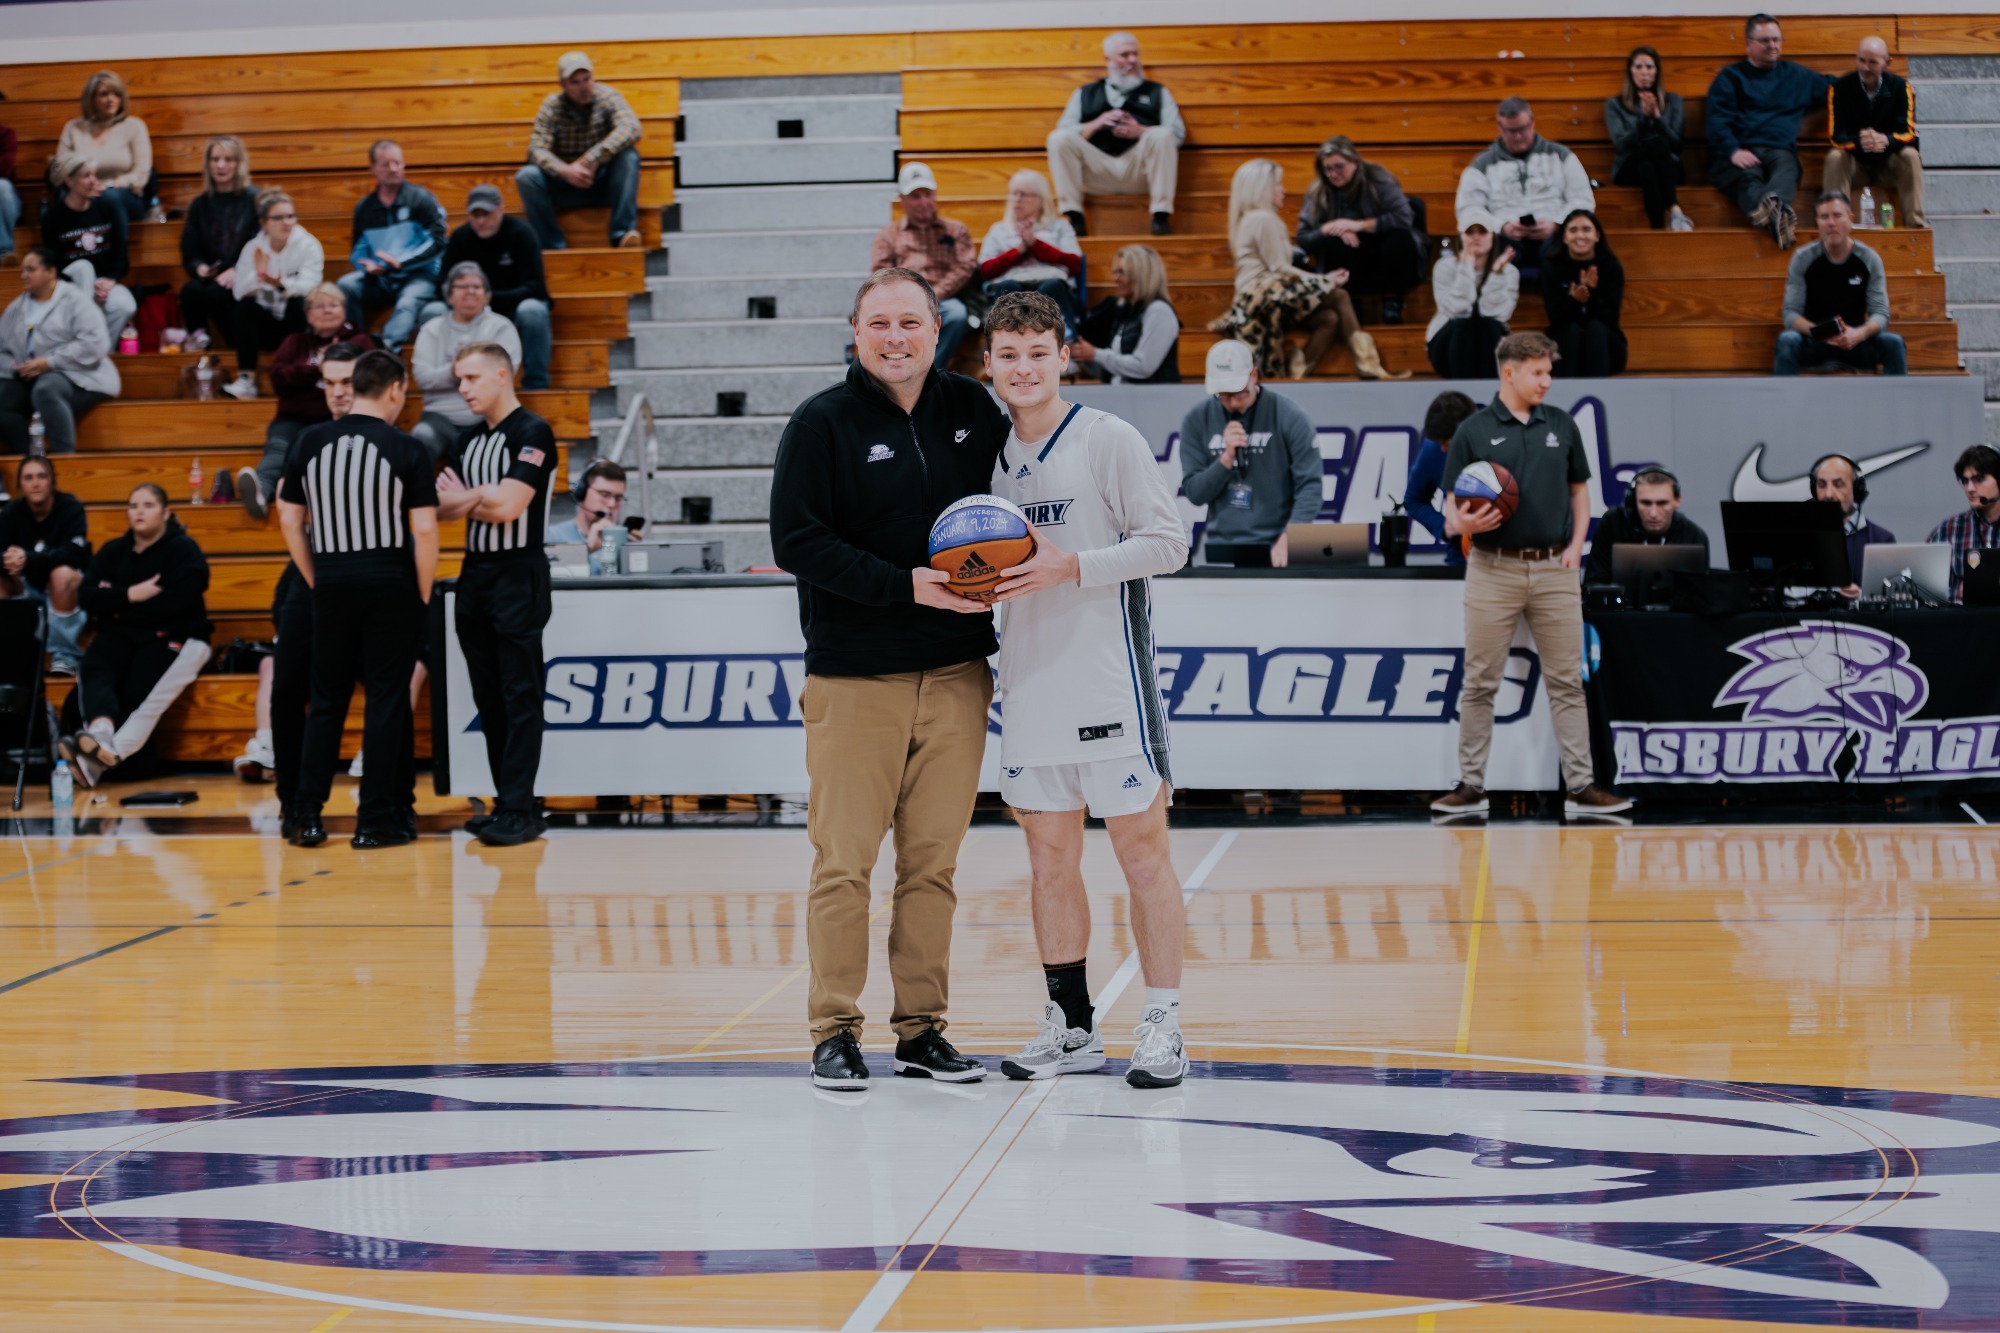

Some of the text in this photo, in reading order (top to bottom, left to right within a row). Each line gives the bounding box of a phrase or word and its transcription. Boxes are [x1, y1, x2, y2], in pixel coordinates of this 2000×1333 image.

[956, 509, 1004, 518] UNIVERSITY
[933, 519, 967, 547] JANUARY
[957, 565, 996, 580] adidas
[1614, 731, 1833, 774] ASBURY
